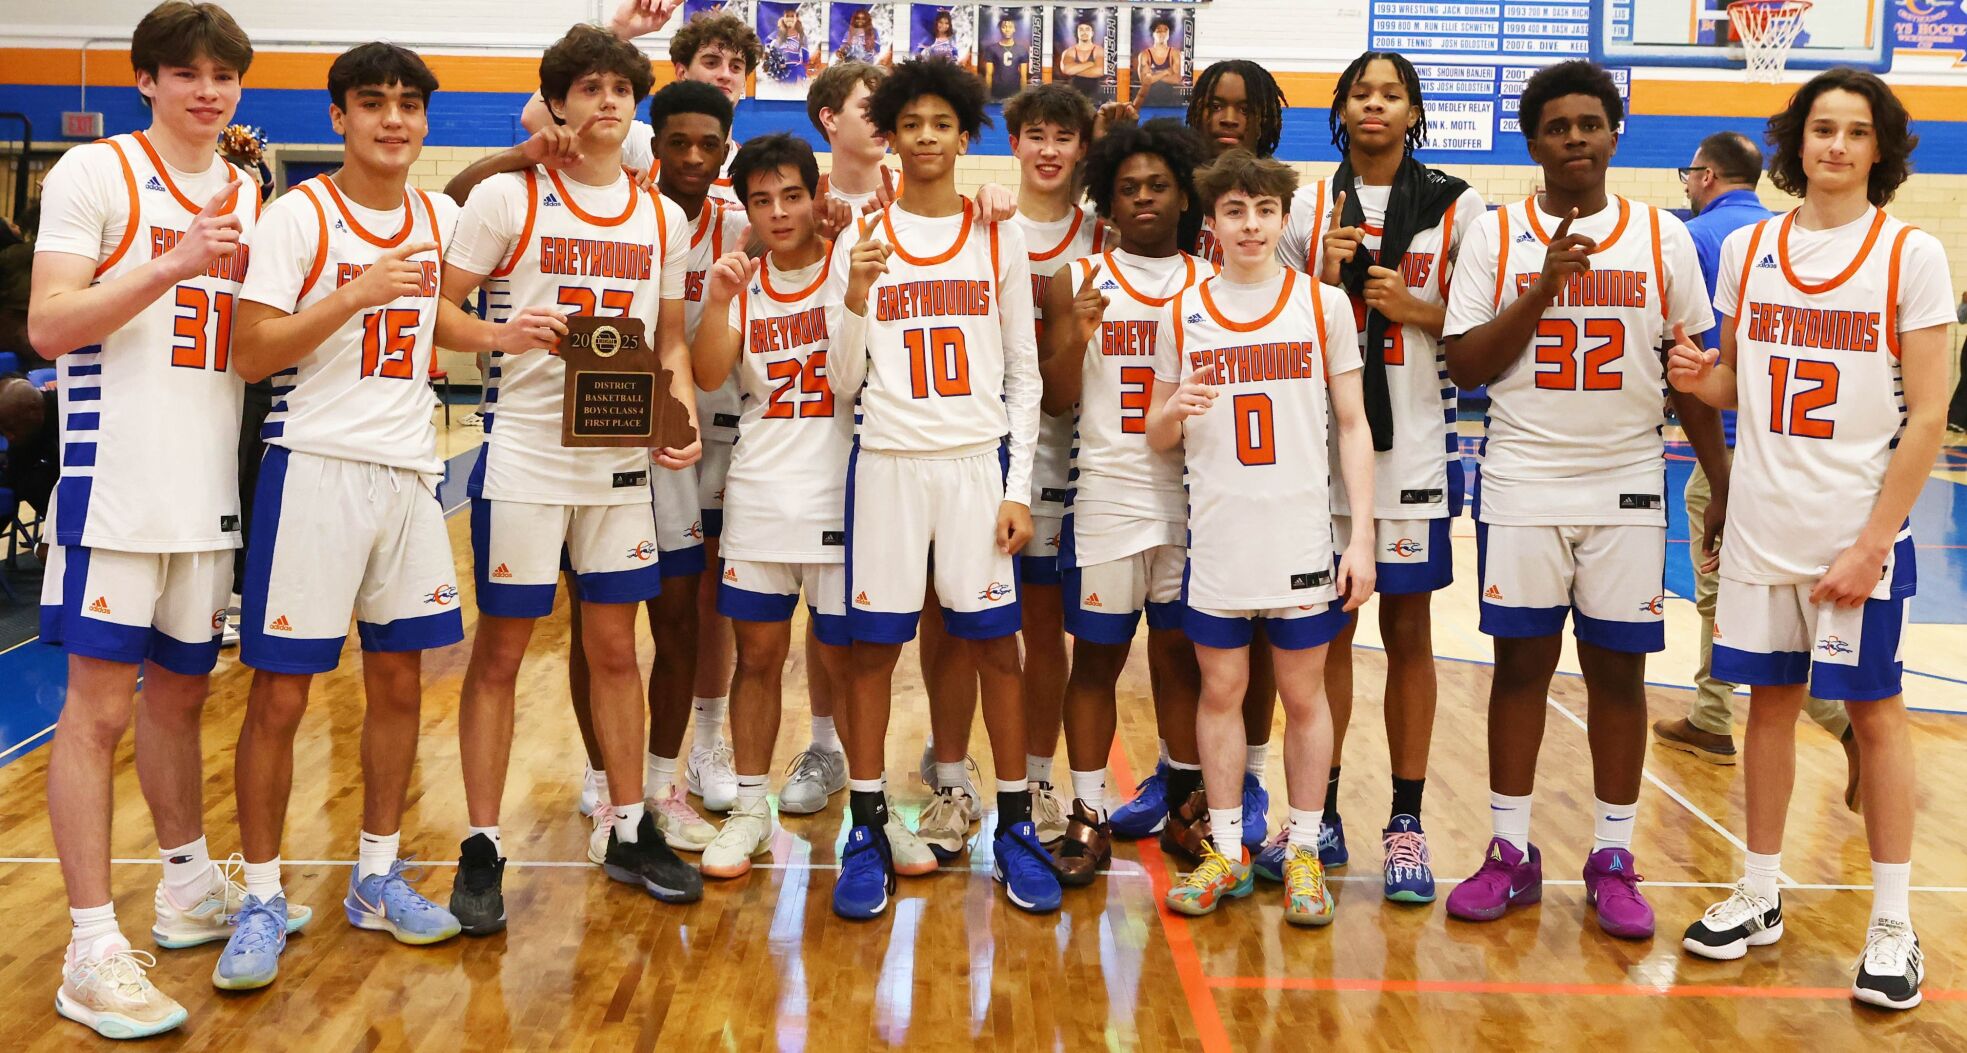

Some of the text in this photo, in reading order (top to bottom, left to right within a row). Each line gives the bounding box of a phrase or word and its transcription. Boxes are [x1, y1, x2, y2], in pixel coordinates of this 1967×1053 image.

[1377, 4, 1496, 15] 1993 WRESTLING JACK DURHAM
[1507, 7, 1526, 16] 1993
[1552, 8, 1569, 16] DASH
[1376, 21, 1396, 30] 1999
[1424, 22, 1438, 31] RUN
[1441, 22, 1458, 31] ELLIE
[1506, 24, 1526, 32] 1999
[1551, 25, 1568, 33] DASH
[1376, 38, 1395, 47] 2006
[1407, 39, 1433, 47] TENNIS
[1440, 39, 1457, 48] JOSH
[1460, 40, 1495, 49] GOLDSTEIN
[1506, 41, 1525, 50] 2007
[1539, 41, 1558, 50] DIVE
[1437, 67, 1464, 77] SHOURIN
[1466, 68, 1493, 78] BANJERI
[1505, 70, 1526, 79] 2001
[1437, 82, 1453, 91] JOSH
[1456, 82, 1490, 92] GOLDSTEIN
[1438, 102, 1467, 112] MEDLEY
[1469, 103, 1491, 112] RELAY
[1440, 121, 1448, 130] K.
[1450, 121, 1476, 130] MOTTL
[1432, 138, 1440, 147] A.
[1443, 138, 1482, 148] STOUFFER
[145, 184, 166, 192] adidas
[540, 236, 653, 280] GREYHOUNDS
[876, 280, 990, 321] GREYHOUNDS
[171, 285, 234, 373] 31
[1747, 301, 1881, 353] GREYHOUNDS
[360, 308, 421, 380] 15
[1534, 317, 1625, 391] 32
[903, 326, 972, 399] 10
[1189, 341, 1313, 386] GREYHOUNDS
[594, 381, 637, 390] DISTRICT
[761, 350, 835, 418] 25
[585, 394, 644, 402] BASKETBALL
[1768, 355, 1840, 440] 12
[583, 406, 644, 415] BOYS CLASS 4
[584, 419, 642, 427] FIRST PLACE
[1233, 392, 1276, 467] 0
[88, 605, 112, 615] adidas
[269, 624, 293, 632] adidas
